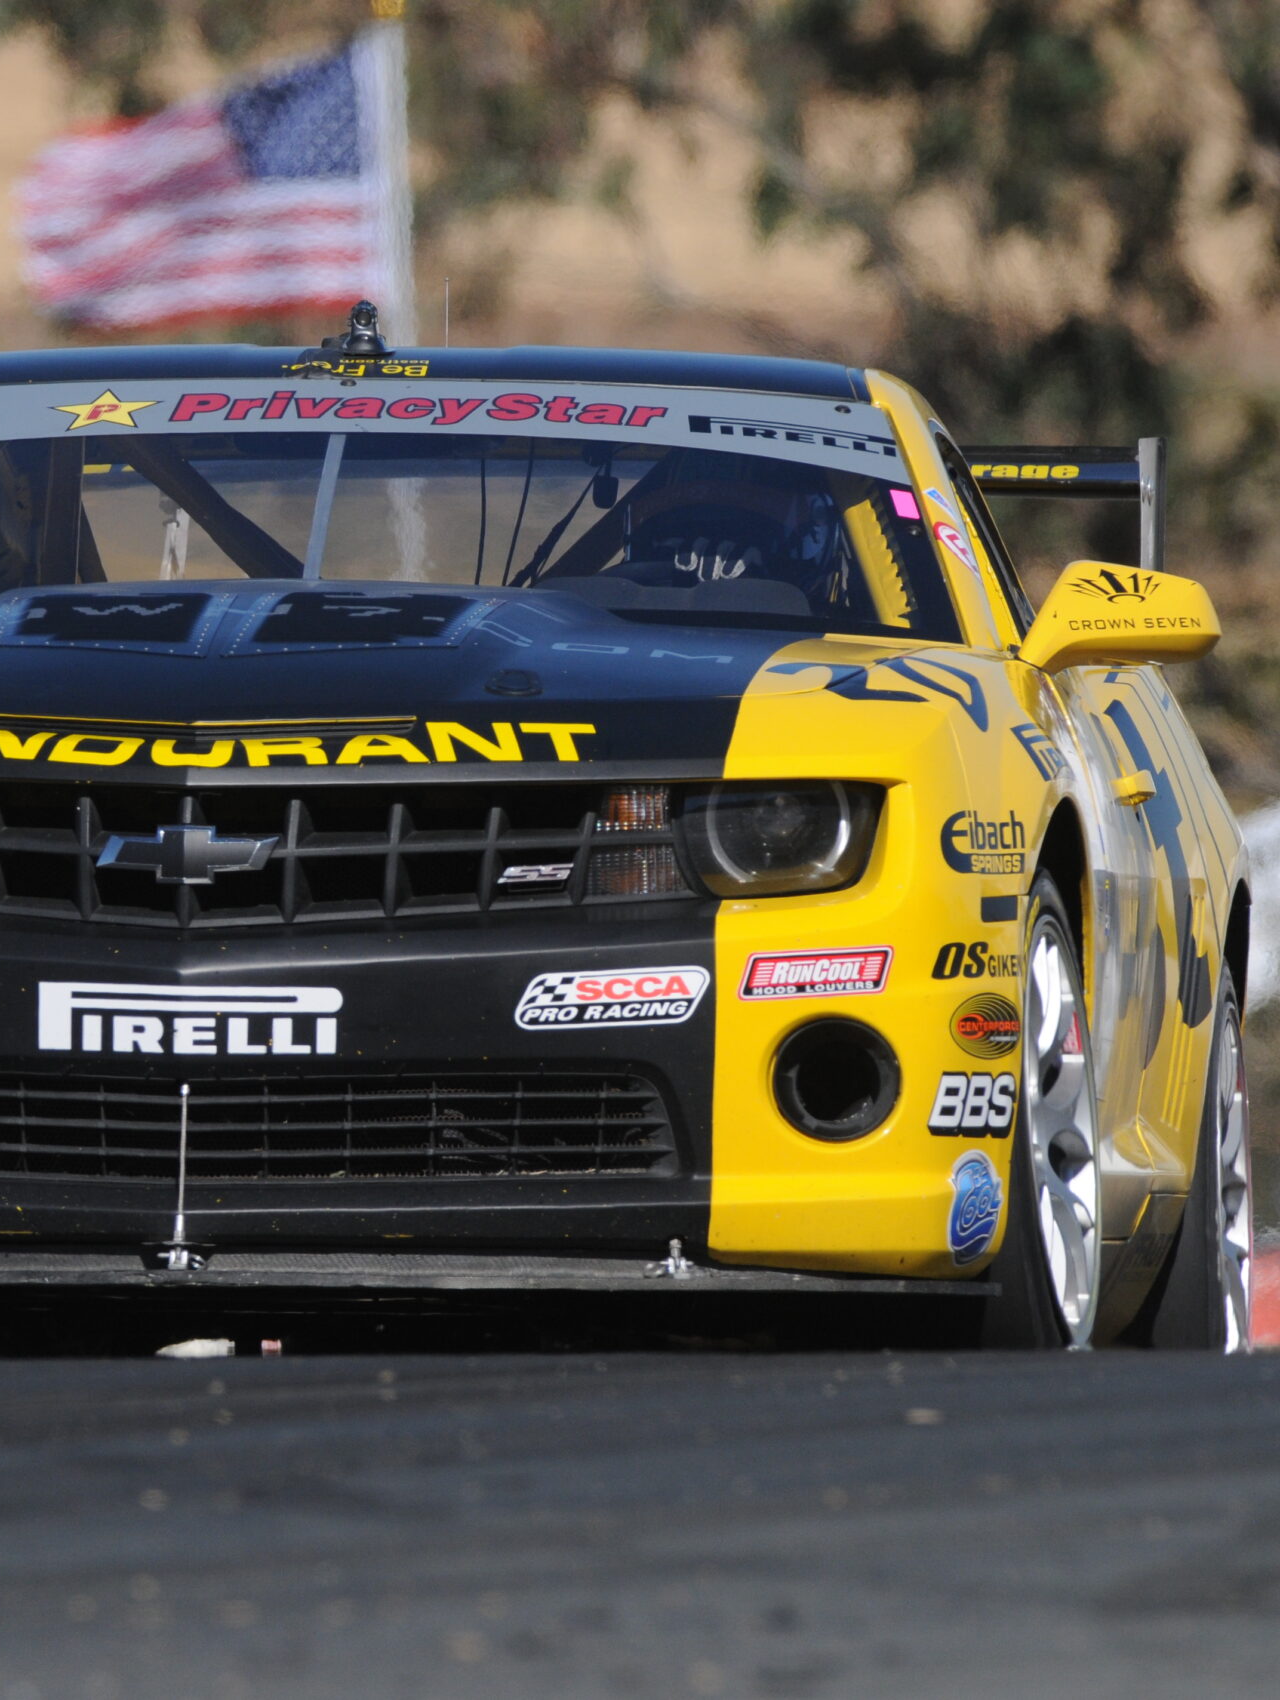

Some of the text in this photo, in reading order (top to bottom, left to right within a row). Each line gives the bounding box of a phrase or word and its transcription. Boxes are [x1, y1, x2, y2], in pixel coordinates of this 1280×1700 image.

[381, 364, 429, 377] Be
[167, 390, 669, 428] PrivacyStar
[687, 414, 898, 458] PIRELLI
[970, 463, 1080, 480] rage
[1068, 616, 1202, 632] CROWN SEVEN
[939, 810, 1026, 874] Eibach
[497, 863, 574, 884] SS
[971, 853, 1023, 874] SPRINGS
[931, 941, 989, 980] OS
[575, 975, 691, 1001] SCCA
[752, 980, 875, 996] HOOD LOUVERS
[38, 981, 343, 1055] PIRELLI
[522, 1001, 689, 1023] PRO RACING
[927, 1072, 1017, 1137] BBS
